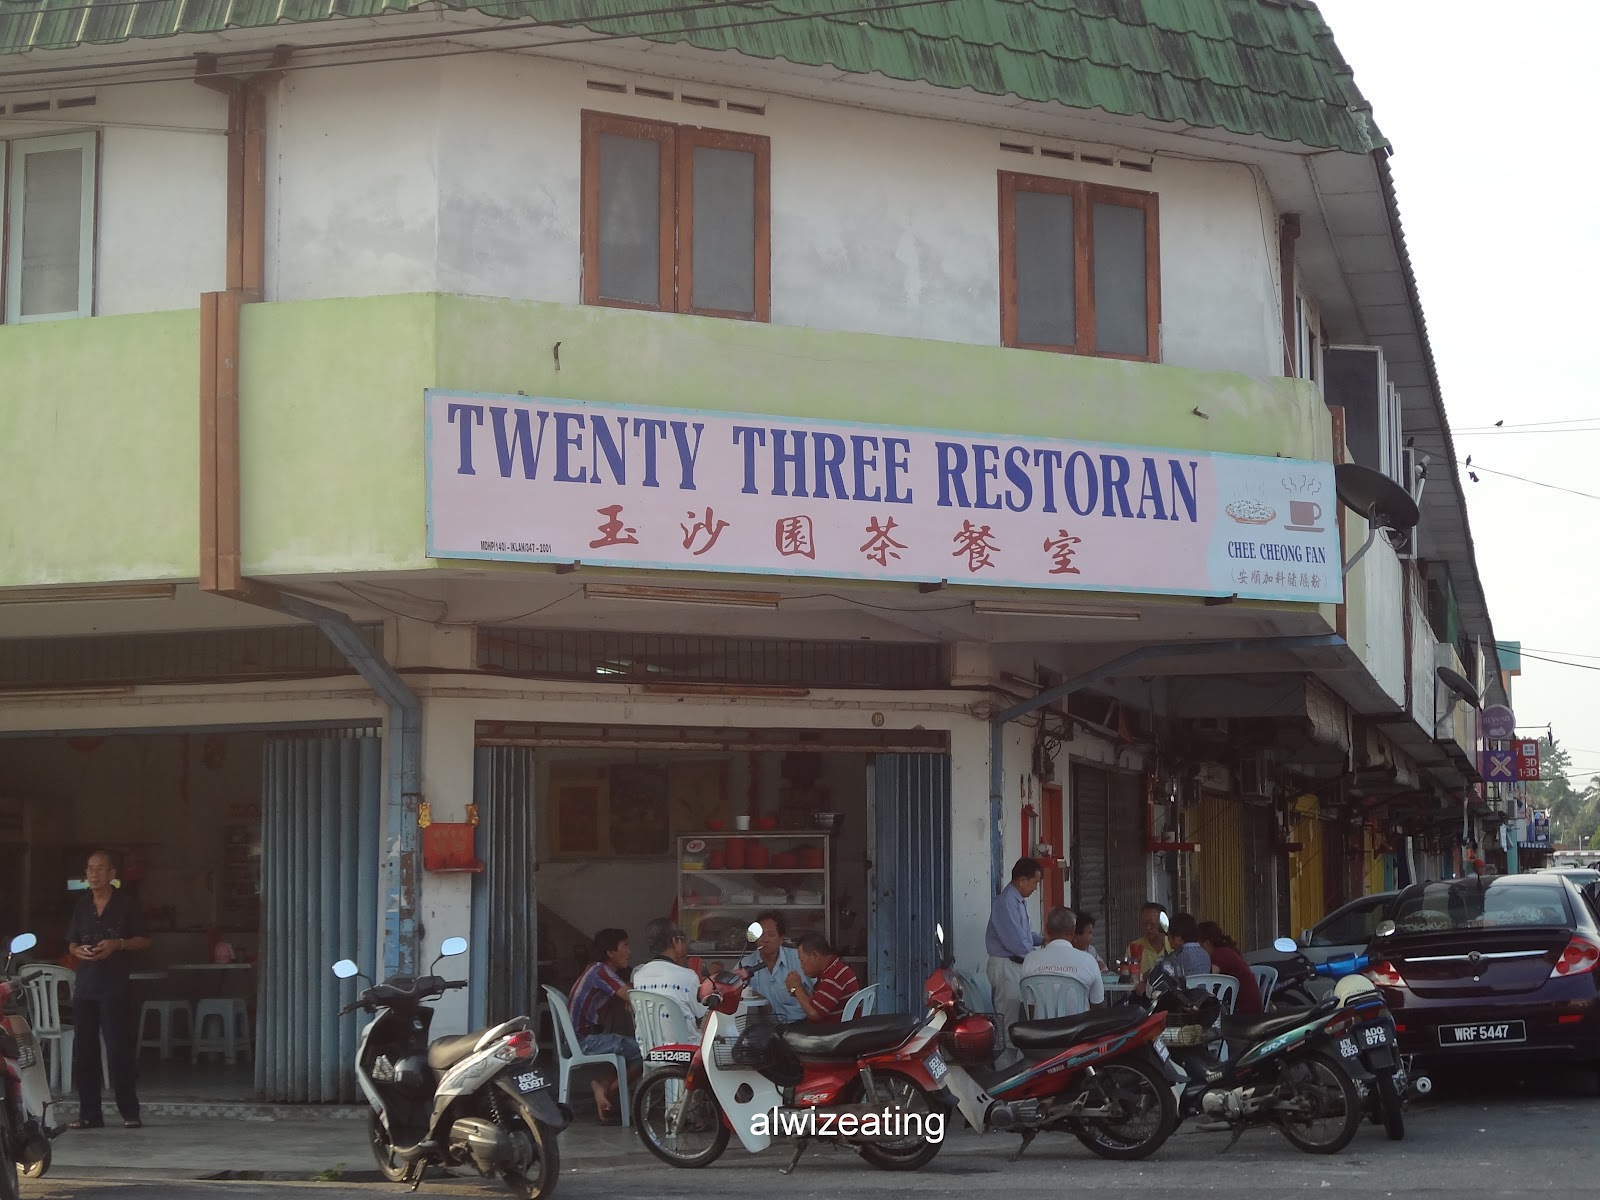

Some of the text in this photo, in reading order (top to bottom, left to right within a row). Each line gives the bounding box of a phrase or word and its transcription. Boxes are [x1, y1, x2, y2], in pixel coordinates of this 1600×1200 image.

[448, 403, 1198, 523] TWENTY THREE RESTORAN
[1228, 541, 1326, 564] CHEE CHEONG FAN
[1525, 758, 1537, 767] 3D
[1454, 1024, 1509, 1041] WRF 5447
[1366, 1033, 1386, 1046] 876
[650, 1051, 690, 1061] BEH2488
[929, 1056, 941, 1070] BEH
[519, 1077, 544, 1090] 8097
